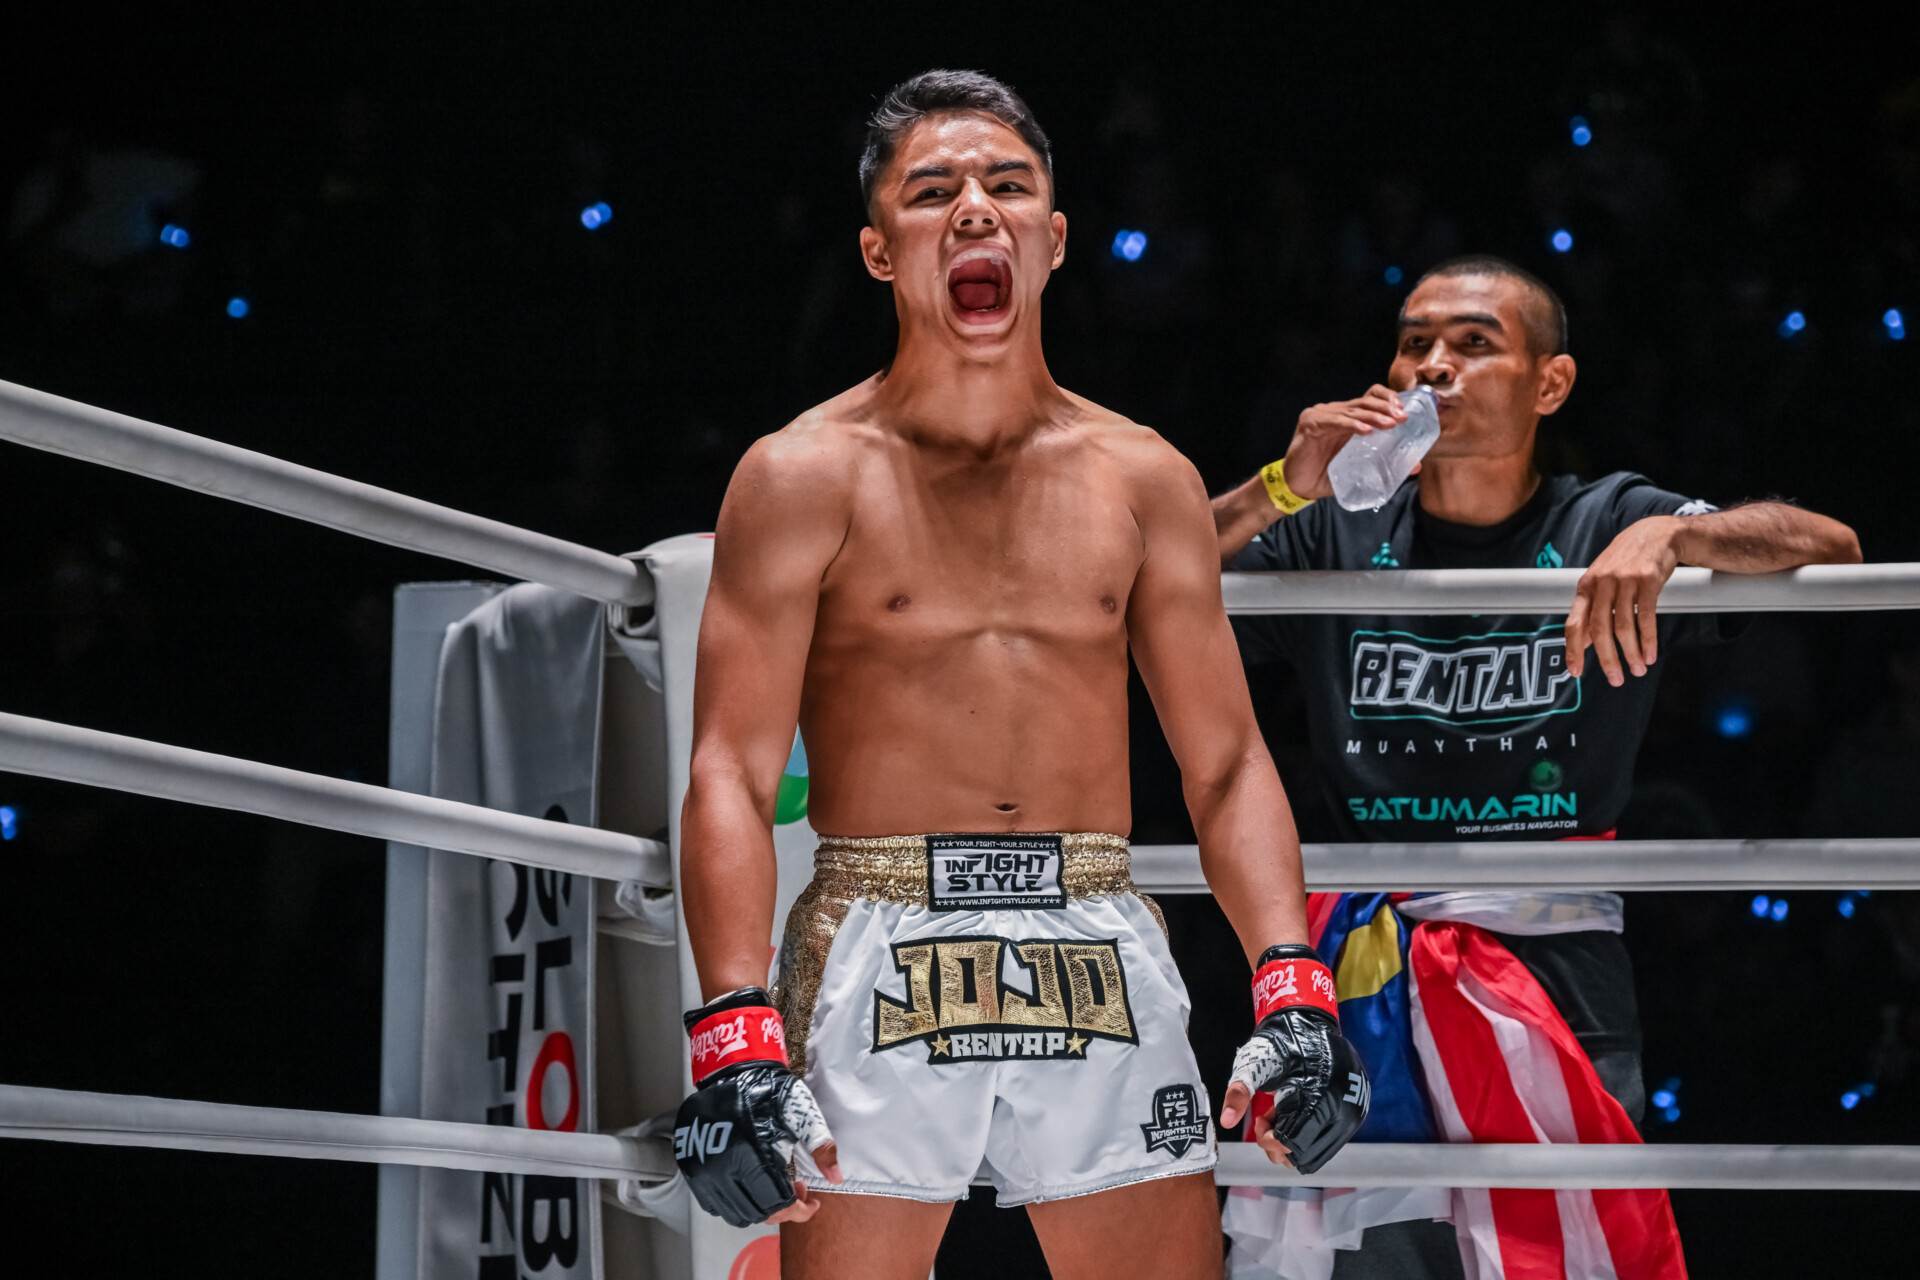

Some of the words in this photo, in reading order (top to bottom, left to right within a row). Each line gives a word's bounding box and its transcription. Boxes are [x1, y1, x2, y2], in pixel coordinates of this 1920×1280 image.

[1351, 638, 1573, 713] RENTAP
[1348, 792, 1577, 821] SATUMARIN
[1455, 825, 1481, 834] YOUR
[1482, 822, 1526, 833] BUSINESS
[1527, 820, 1579, 830] NAVIGATOR
[947, 873, 1043, 892] STYLE
[874, 939, 1135, 1048] JOJO
[522, 804, 580, 1280] GLOB
[950, 1031, 1066, 1058] RENTAP
[1162, 1099, 1189, 1119] FS
[675, 1116, 734, 1164] ONE
[1150, 1123, 1204, 1142] INFIGHTSTYLE
